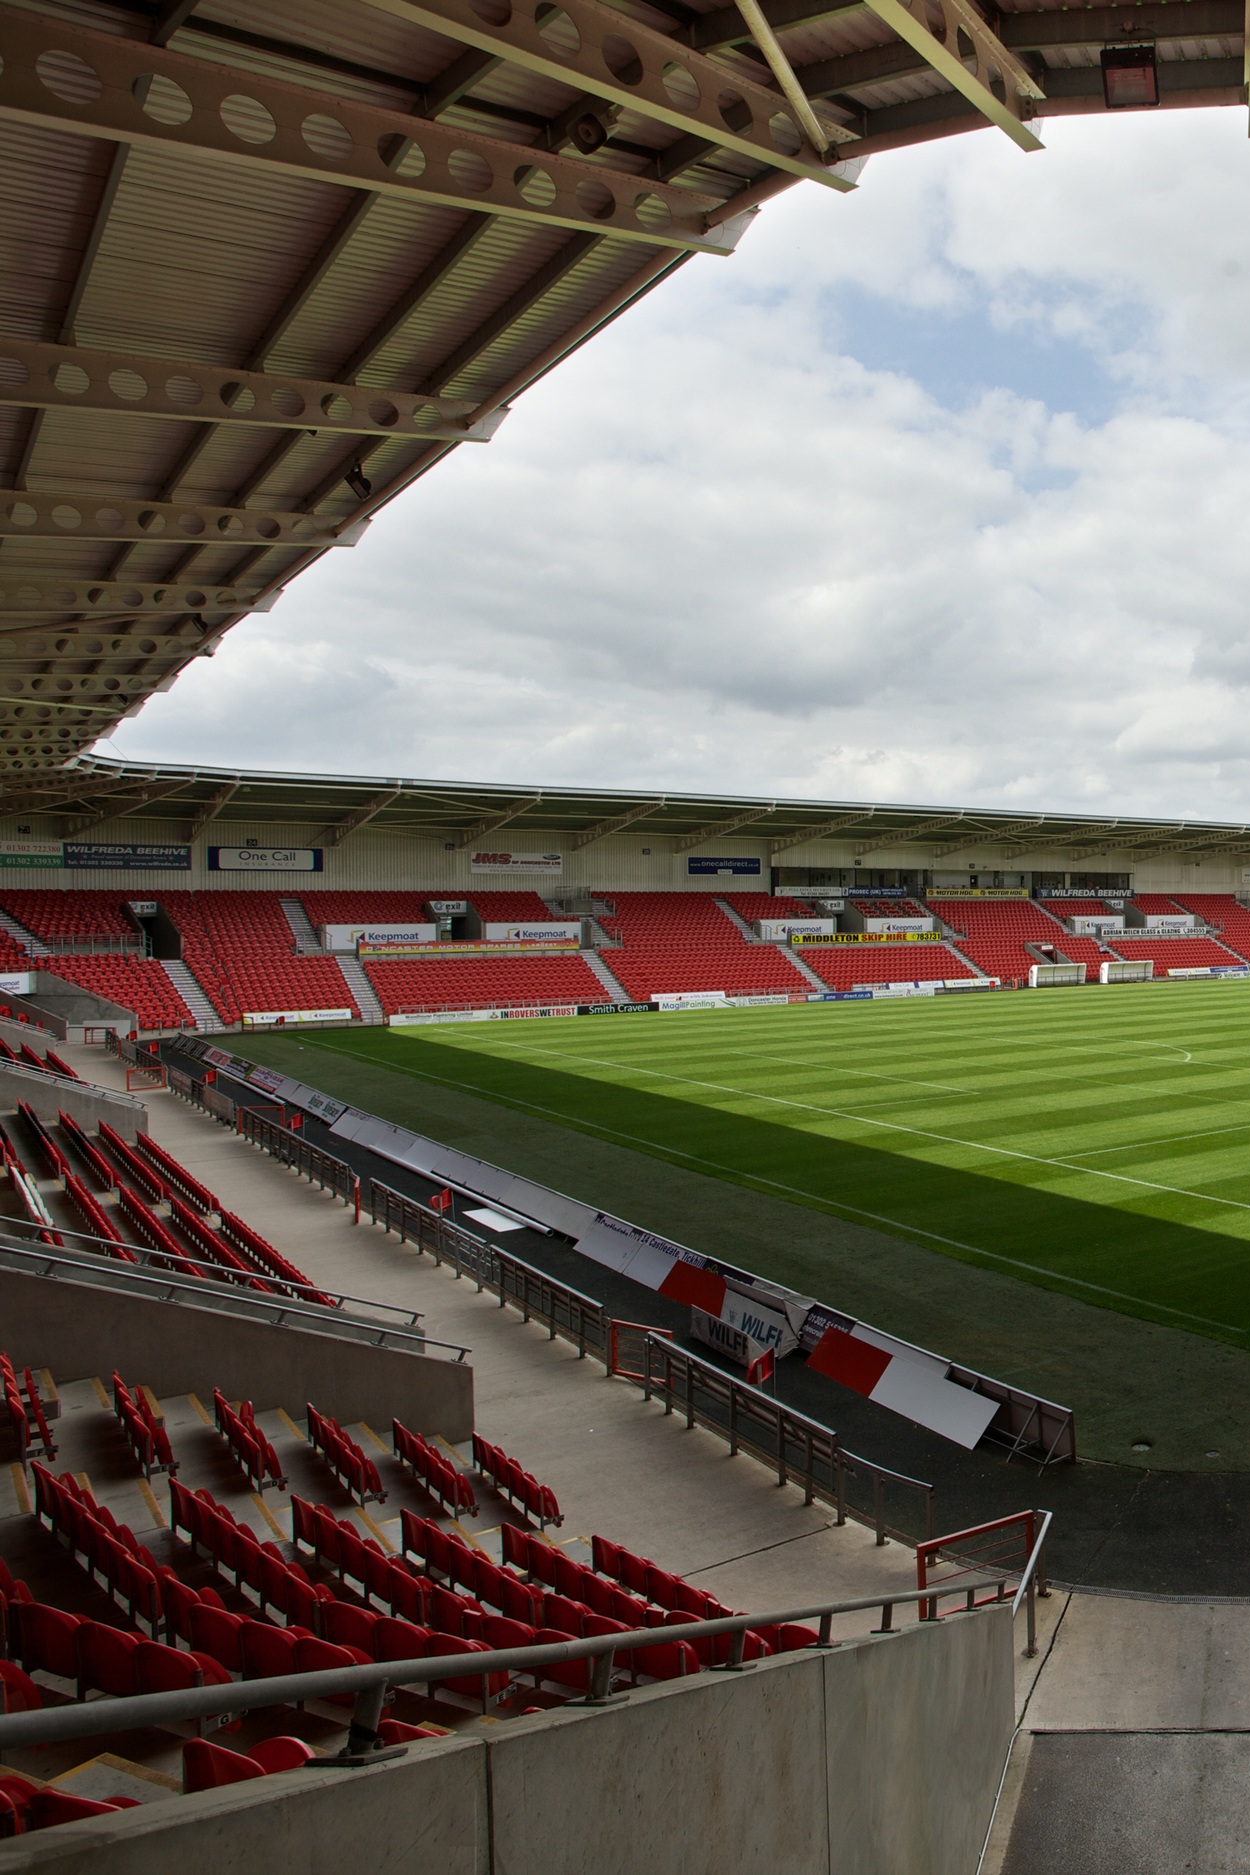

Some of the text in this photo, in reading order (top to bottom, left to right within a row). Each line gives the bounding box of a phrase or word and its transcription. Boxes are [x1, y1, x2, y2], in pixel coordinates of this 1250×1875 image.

[6, 844, 31, 852] 01302
[67, 846, 188, 856] WILFREDA BEEHIVE
[6, 857, 31, 865] 01302
[238, 851, 296, 861] One Call
[472, 853, 512, 865] JMS
[445, 902, 461, 910] exit
[892, 924, 922, 932] Keepmoat
[368, 932, 419, 941] Keepmoat
[522, 931, 567, 939] Keepmoat
[802, 932, 940, 943] MIDDLETON SKIP HIRE 783731
[589, 1003, 648, 1014] Smith Craven
[640, 1234, 649, 1244] 14
[681, 1251, 707, 1268] Tickhill
[807, 1313, 827, 1327] 01302
